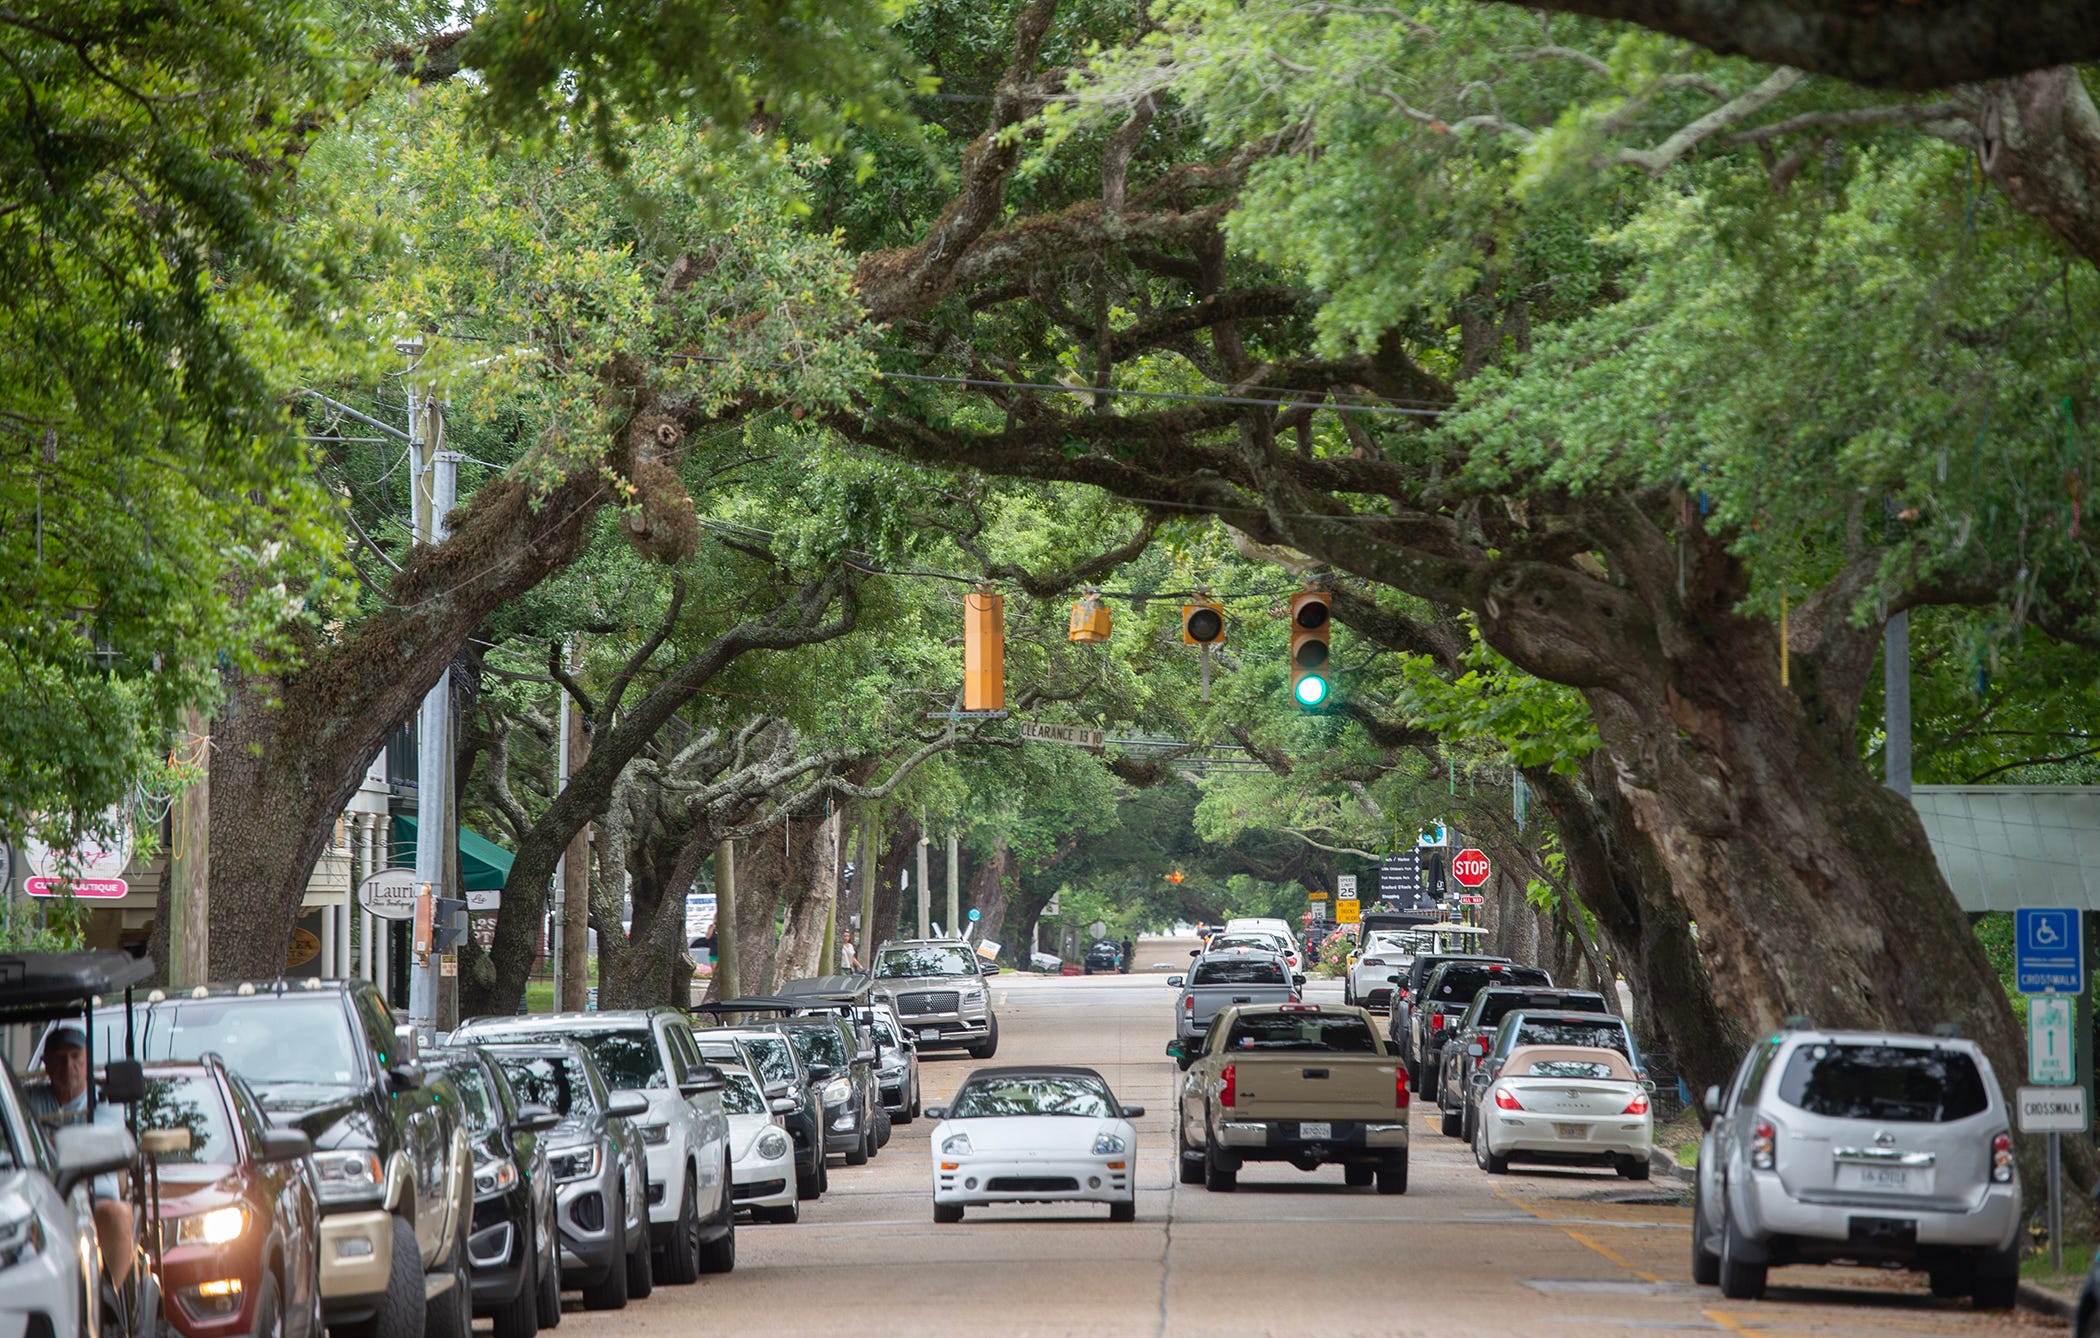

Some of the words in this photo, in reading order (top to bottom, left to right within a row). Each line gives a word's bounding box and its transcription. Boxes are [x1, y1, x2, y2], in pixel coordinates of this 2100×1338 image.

[1021, 722, 1073, 741] CLEARANCE
[1455, 860, 1488, 875] STOP
[1340, 888, 1355, 897] 25
[2021, 974, 2078, 985] CROSSWALK
[2024, 1102, 2082, 1116] CROSSWALK
